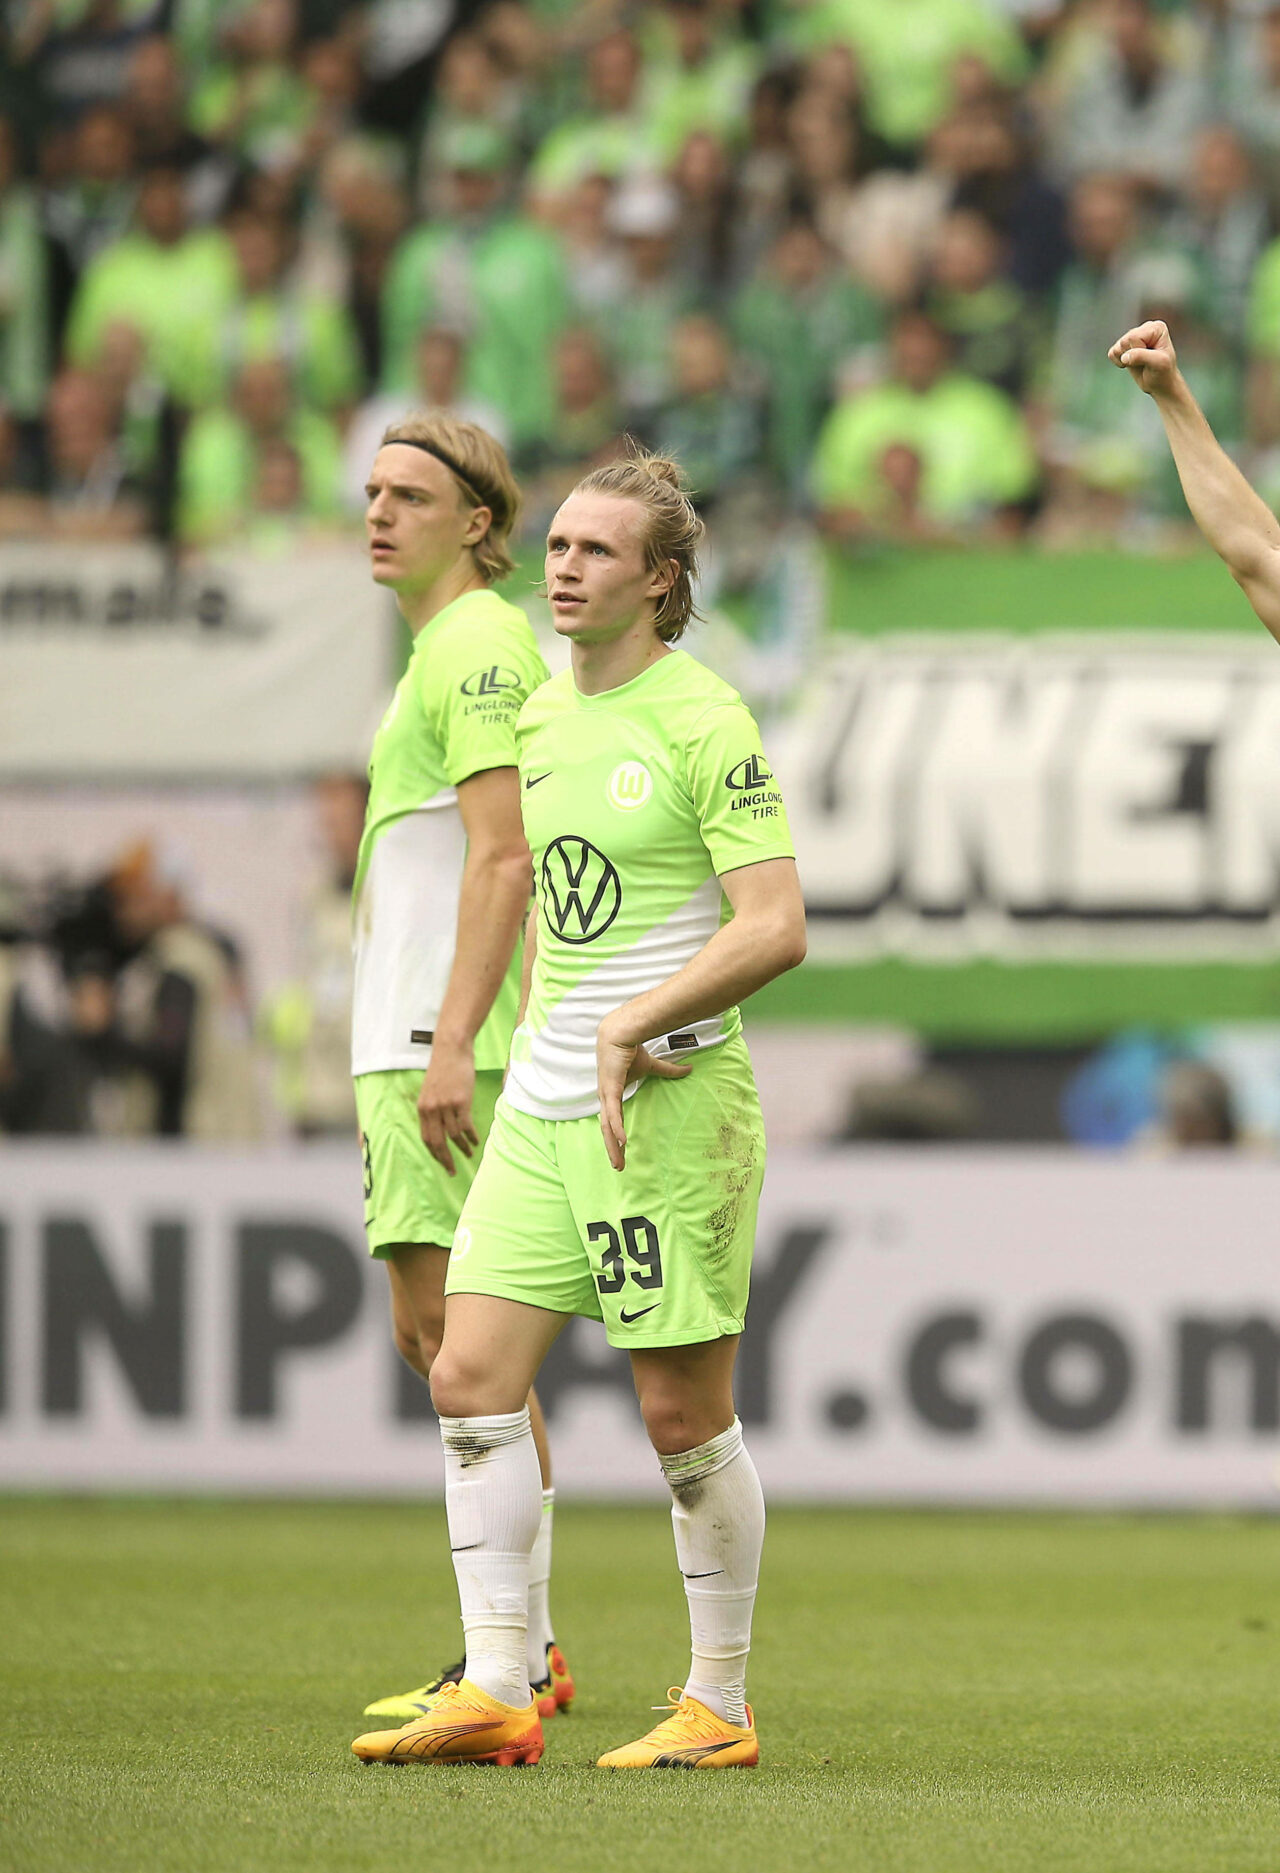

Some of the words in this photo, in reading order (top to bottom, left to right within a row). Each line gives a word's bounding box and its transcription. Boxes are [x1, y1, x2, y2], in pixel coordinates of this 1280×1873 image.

[481, 712, 512, 724] TIRE
[731, 792, 783, 811] LINGLONG
[751, 806, 779, 820] TIRE
[586, 1215, 664, 1294] 39
